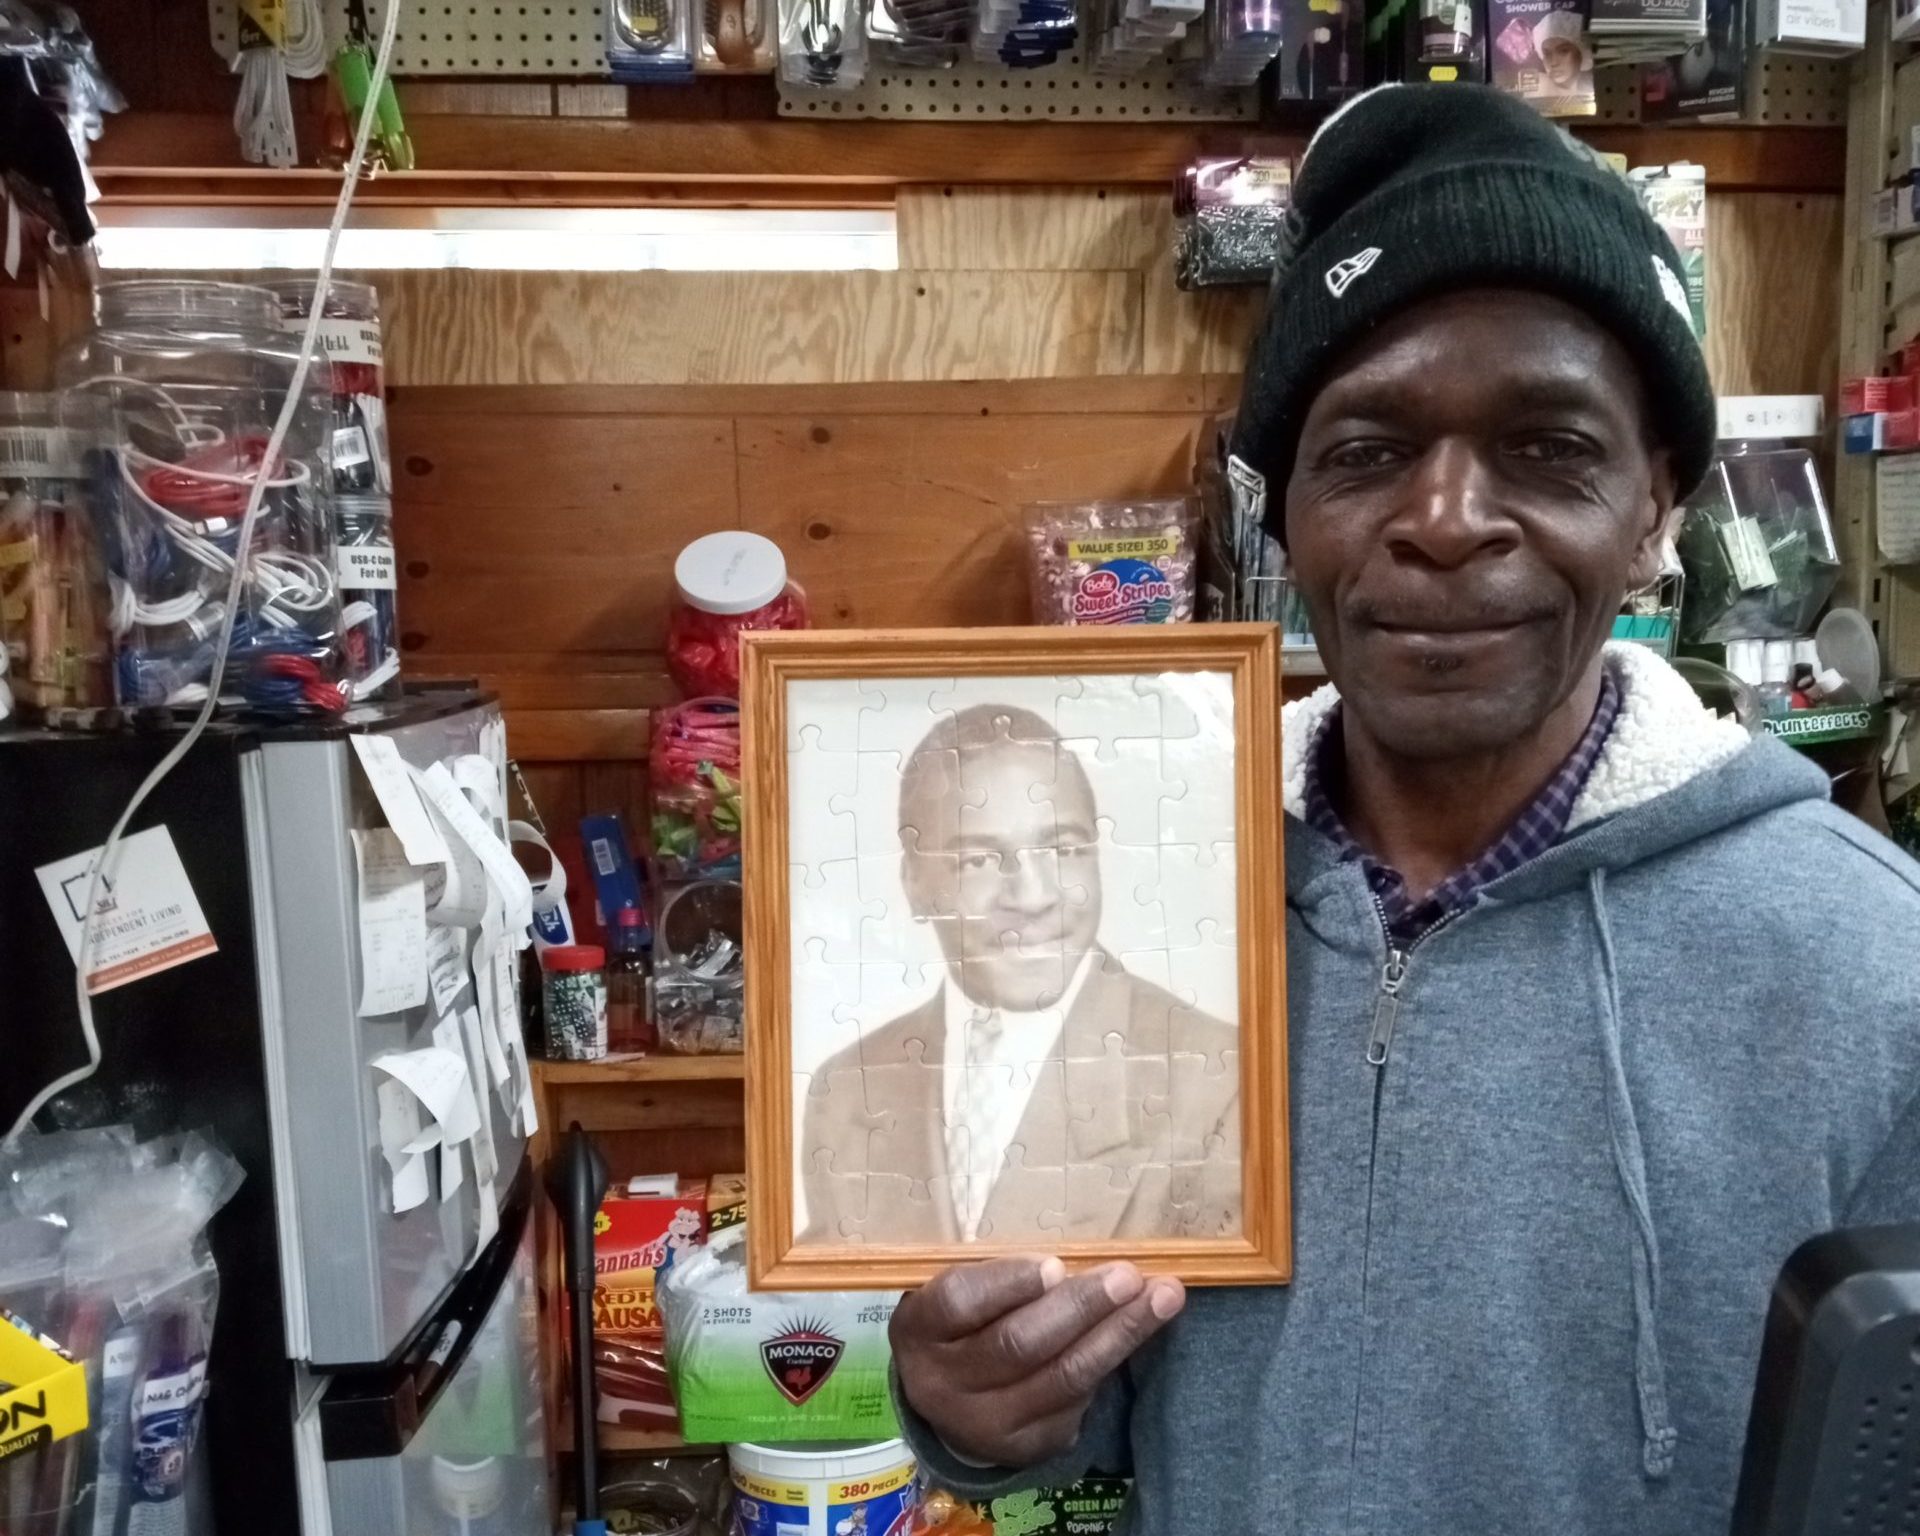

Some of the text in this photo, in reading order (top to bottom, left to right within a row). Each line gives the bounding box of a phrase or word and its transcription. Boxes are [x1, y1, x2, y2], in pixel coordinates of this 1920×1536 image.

[1505, 1, 1576, 14] SHOWER CAP
[1807, 13, 1836, 28] vibes
[1076, 539, 1169, 554] VALUE SIZE! 350
[351, 555, 377, 565] USB-C
[360, 568, 375, 578] For
[1074, 582, 1172, 613] Sweet Stripes
[89, 917, 147, 944] NDEPENDENT
[151, 903, 183, 924] LIVING
[596, 1245, 666, 1274] annah's
[595, 1306, 663, 1329] AUSA
[703, 1307, 752, 1318] 2 SHOTS
[856, 1311, 893, 1324] TEQUI
[769, 1345, 836, 1360] MONACO
[749, 1483, 777, 1498] PIECES
[839, 1476, 899, 1500] 380 PIECES
[1063, 1500, 1100, 1512] GREEN
[1066, 1520, 1105, 1535] POPPING
